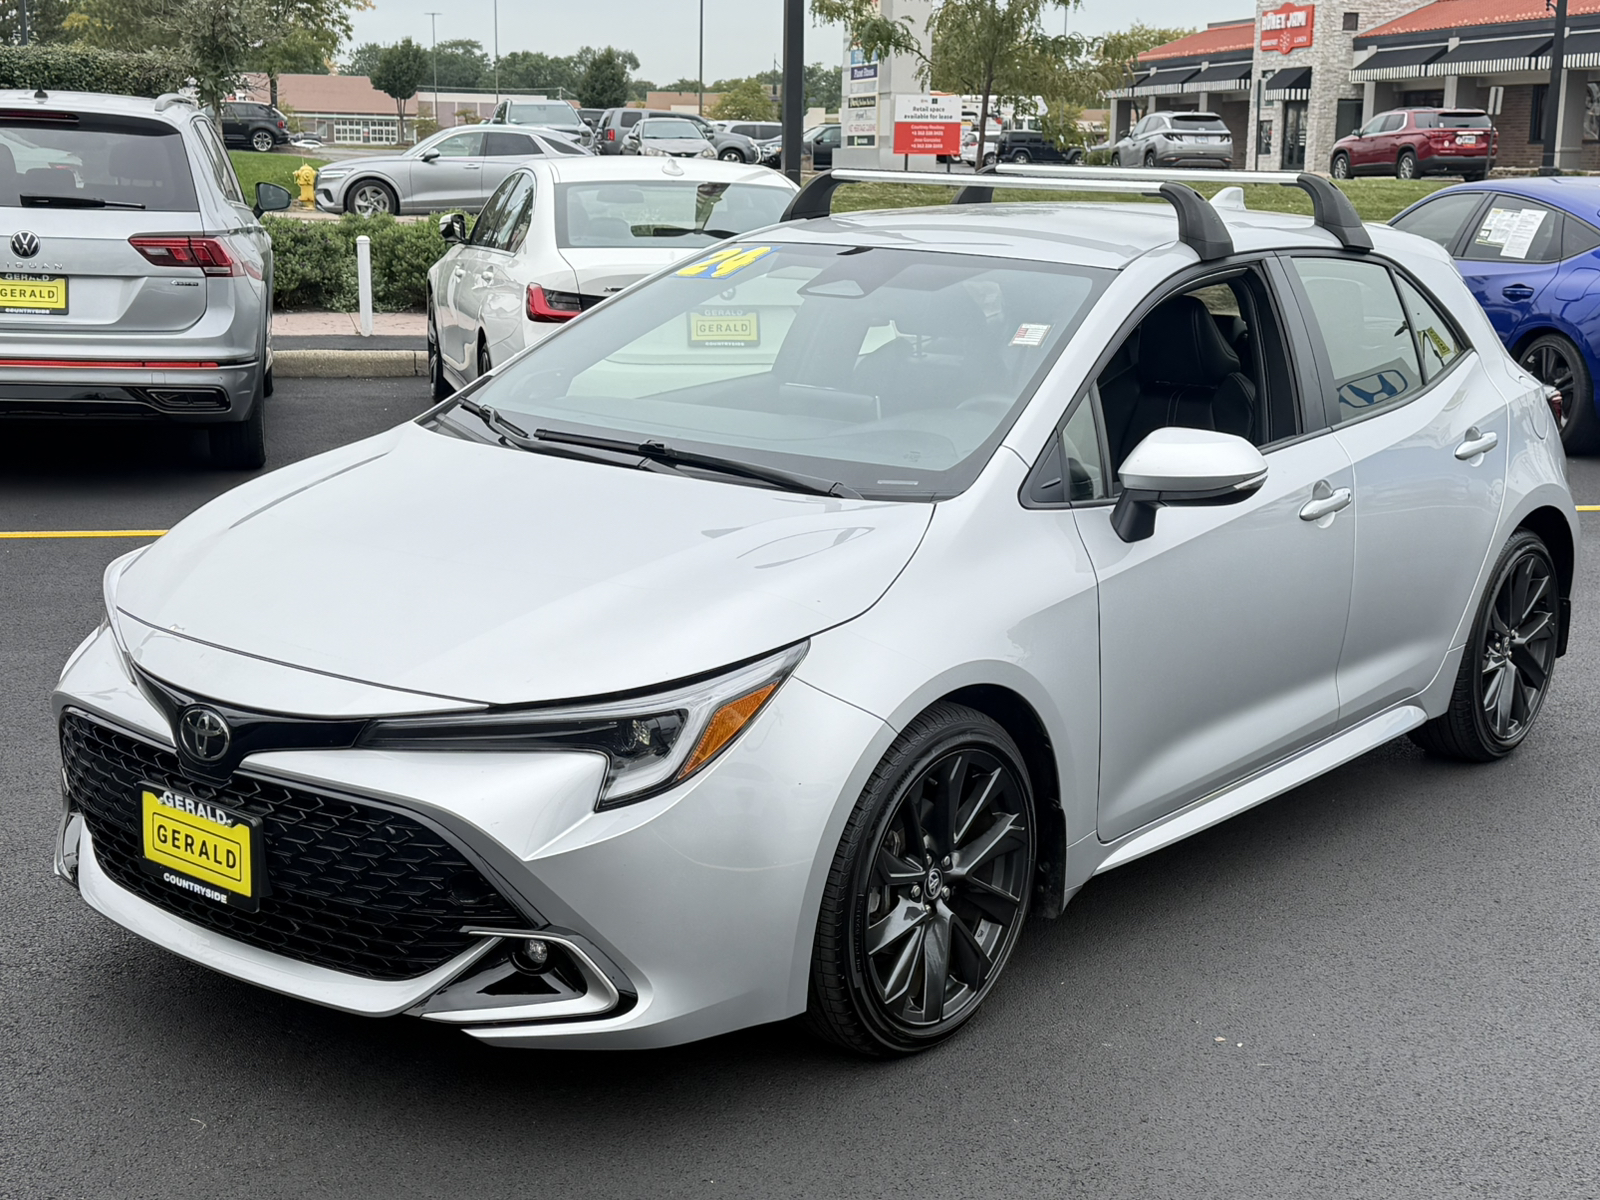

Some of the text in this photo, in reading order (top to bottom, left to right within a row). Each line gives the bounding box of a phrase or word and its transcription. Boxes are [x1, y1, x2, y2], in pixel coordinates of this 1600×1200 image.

[1286, 11, 1306, 28] JAM
[6, 261, 63, 271] IGUAN
[676, 246, 772, 278] 24
[0, 288, 55, 299] GERALD
[704, 309, 743, 317] GERALD
[699, 323, 748, 333] GERALD
[162, 791, 227, 825] GERALD
[157, 824, 236, 869] GERALD
[163, 872, 228, 904] COUNTRYSIDE
